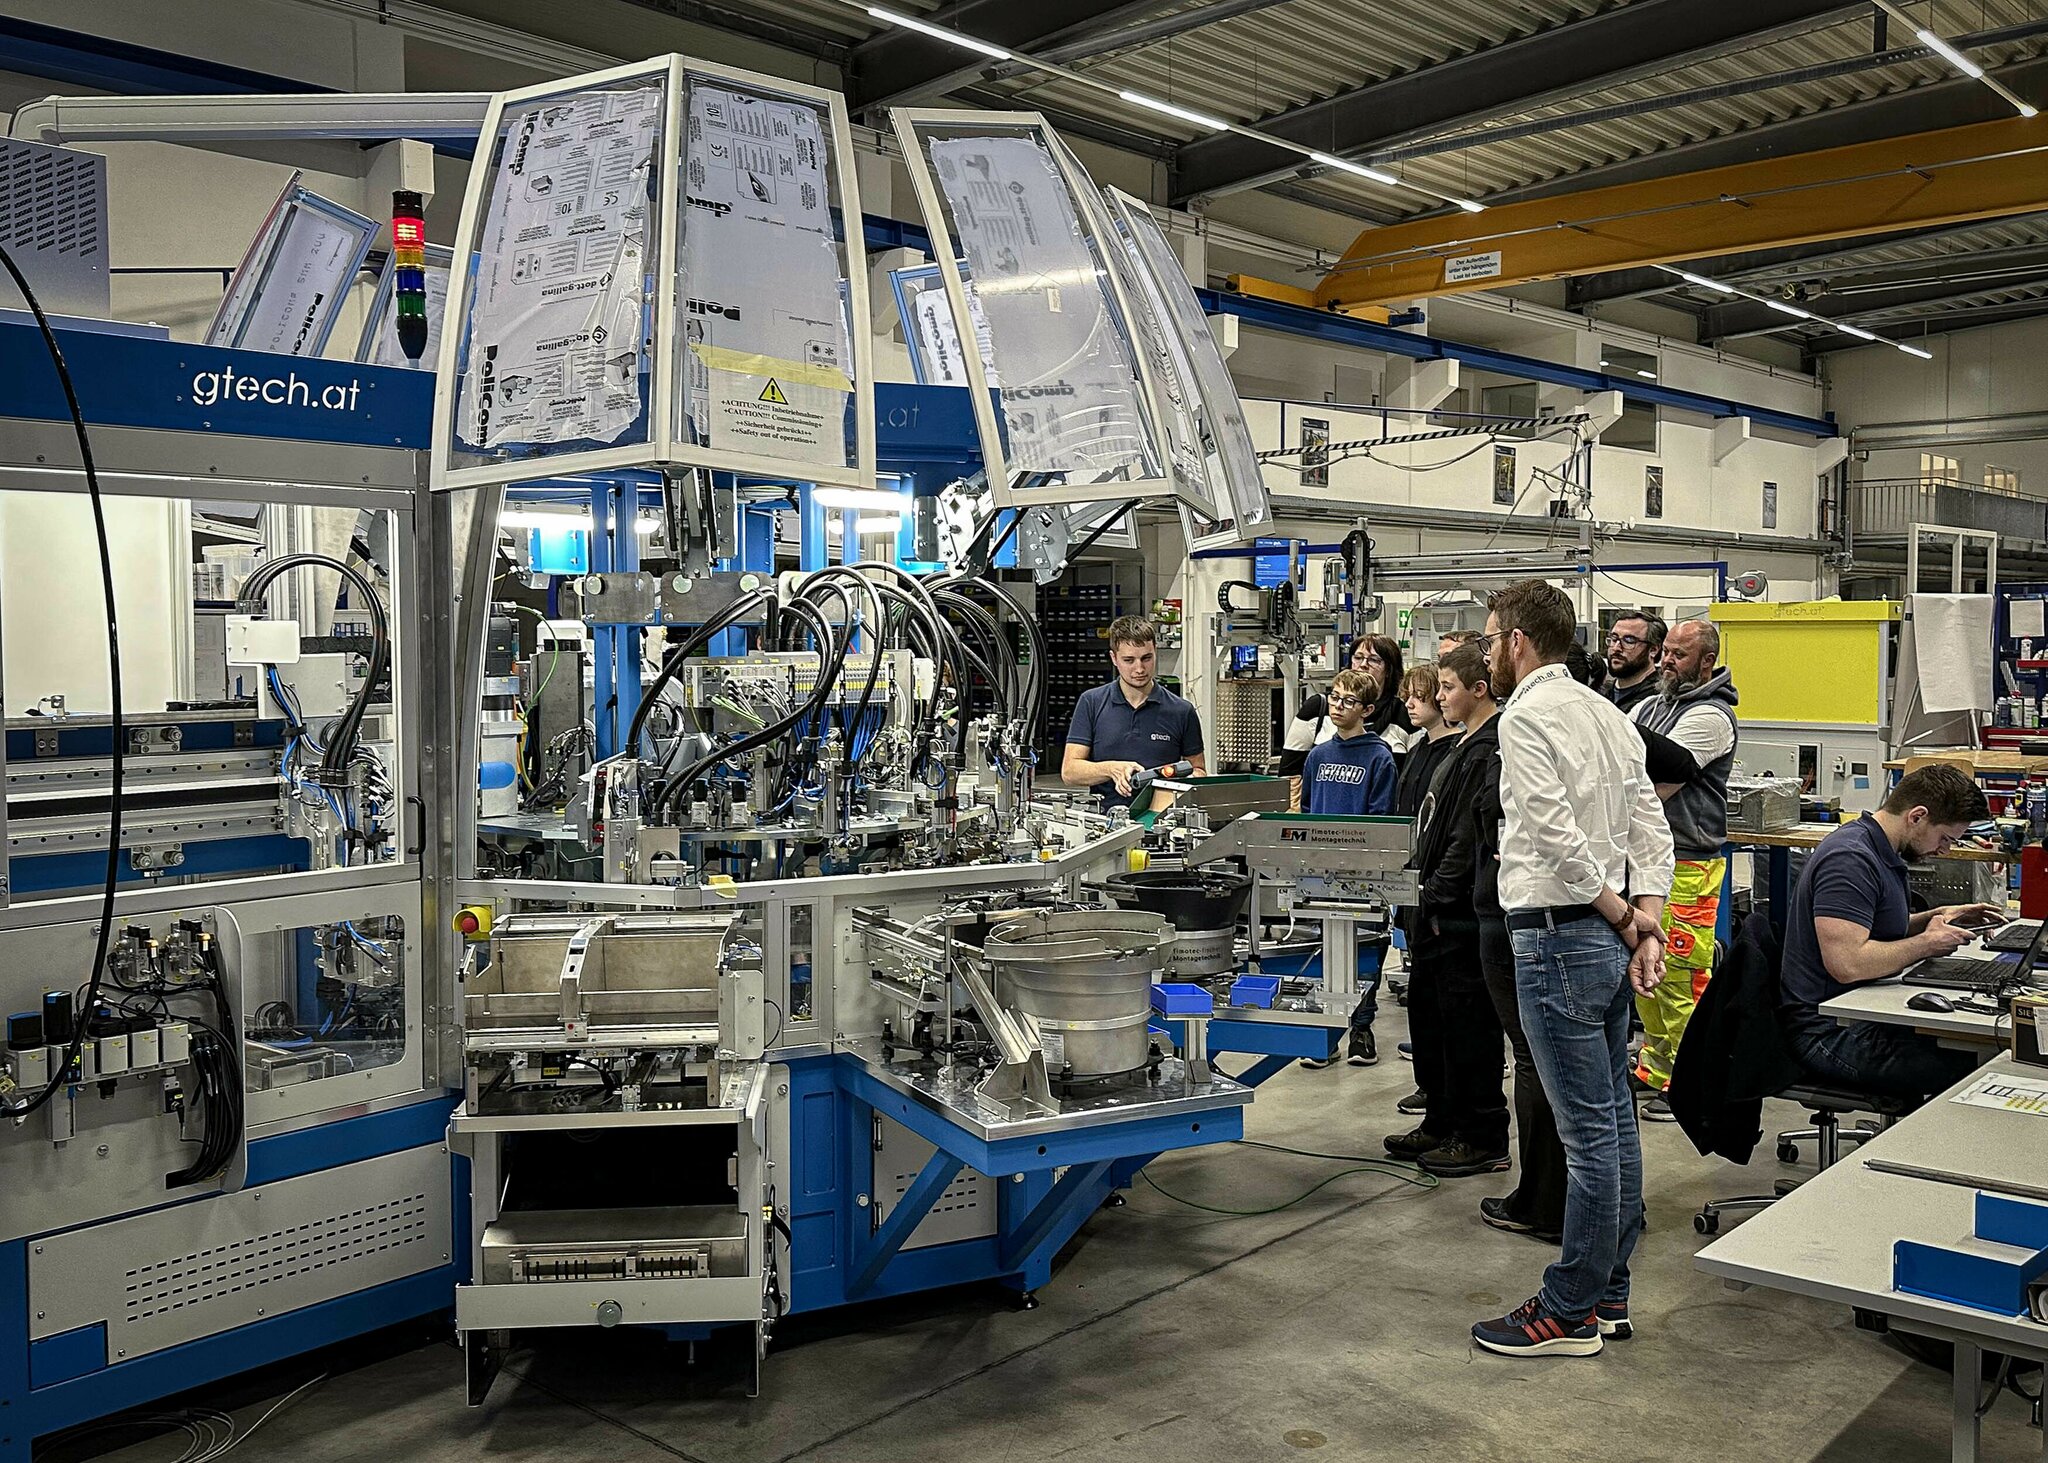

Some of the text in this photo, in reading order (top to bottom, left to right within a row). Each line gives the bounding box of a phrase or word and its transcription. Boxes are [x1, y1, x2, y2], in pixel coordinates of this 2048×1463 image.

[541, 280, 597, 297] dott.gallina
[291, 292, 324, 356] PoliCo
[536, 334, 589, 351] do.gallina
[192, 366, 361, 412] gtech.at
[477, 344, 498, 449] PoliCom
[760, 431, 771, 439] out
[772, 432, 779, 440] of
[1316, 763, 1366, 785] BEYOND
[1311, 828, 1367, 837] fimotec-fischer
[1311, 836, 1367, 844] Montagetechnik
